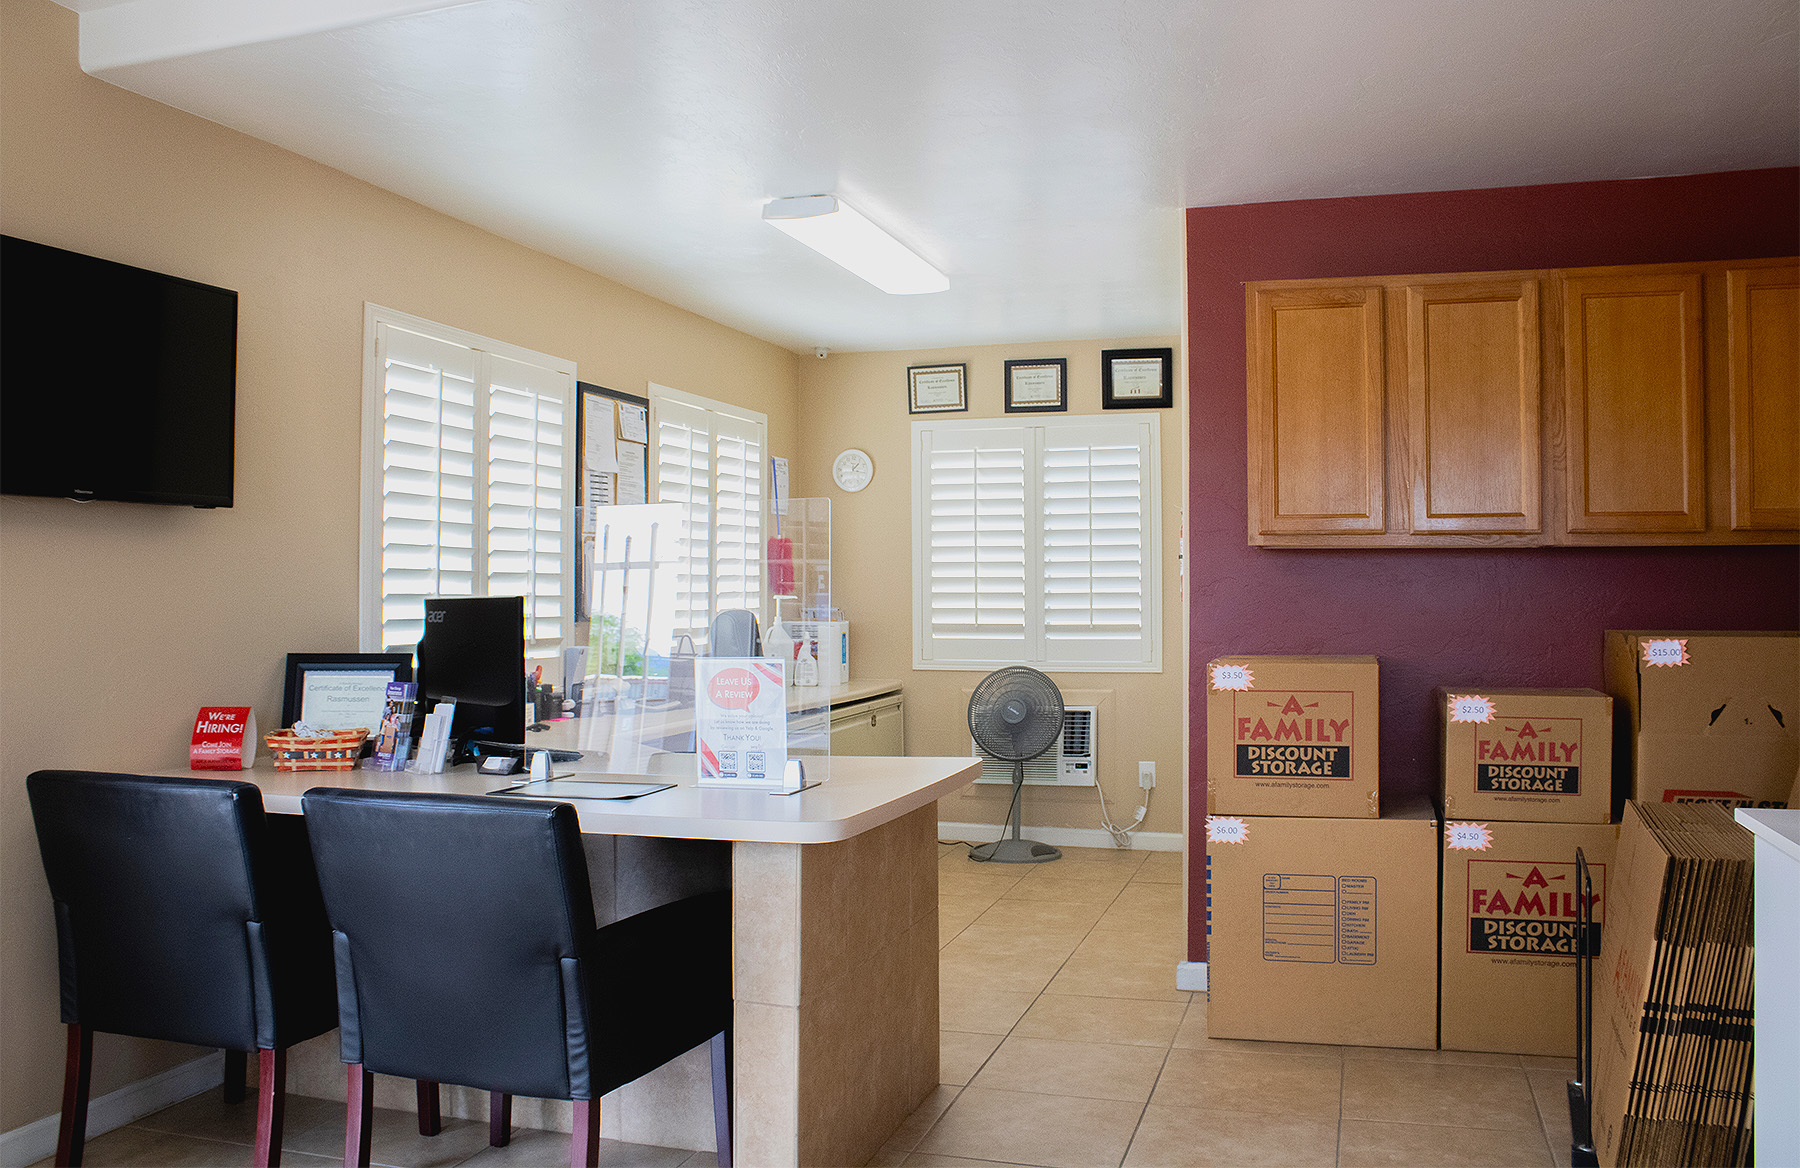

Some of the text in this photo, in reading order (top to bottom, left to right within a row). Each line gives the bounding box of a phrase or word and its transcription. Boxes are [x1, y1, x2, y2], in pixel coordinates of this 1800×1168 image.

[428, 611, 446, 623] acer
[1652, 648, 1680, 657] $15.00
[1221, 671, 1243, 679] $3.50
[716, 677, 752, 686] LEAVE US
[309, 684, 342, 692] Certificate
[343, 684, 352, 692] of
[353, 684, 386, 692] Excellenc
[716, 690, 753, 698] A REVIEW
[327, 695, 370, 703] Rasmussen
[1281, 694, 1304, 716] A
[1462, 706, 1484, 714] $2.50
[196, 721, 244, 733] HIRING!
[1237, 717, 1350, 742] FAMILY
[1518, 721, 1538, 739] A
[723, 733, 744, 741] THANK
[1248, 746, 1339, 761] DISCOUNT
[1479, 740, 1578, 762] FAMILY
[1252, 760, 1333, 775] STORAGE
[1488, 766, 1568, 779] DISCOUNT
[1255, 781, 1330, 789] www.afamilystorage.com
[1491, 778, 1563, 791] STORAGE
[1216, 826, 1238, 834] $6.00
[1457, 832, 1479, 841] $4.50
[1522, 865, 1549, 889] A
[1472, 889, 1601, 918] FAMILY
[1484, 920, 1587, 938] DISCOUNT
[1491, 958, 1577, 968] www.afamilystorage.com
